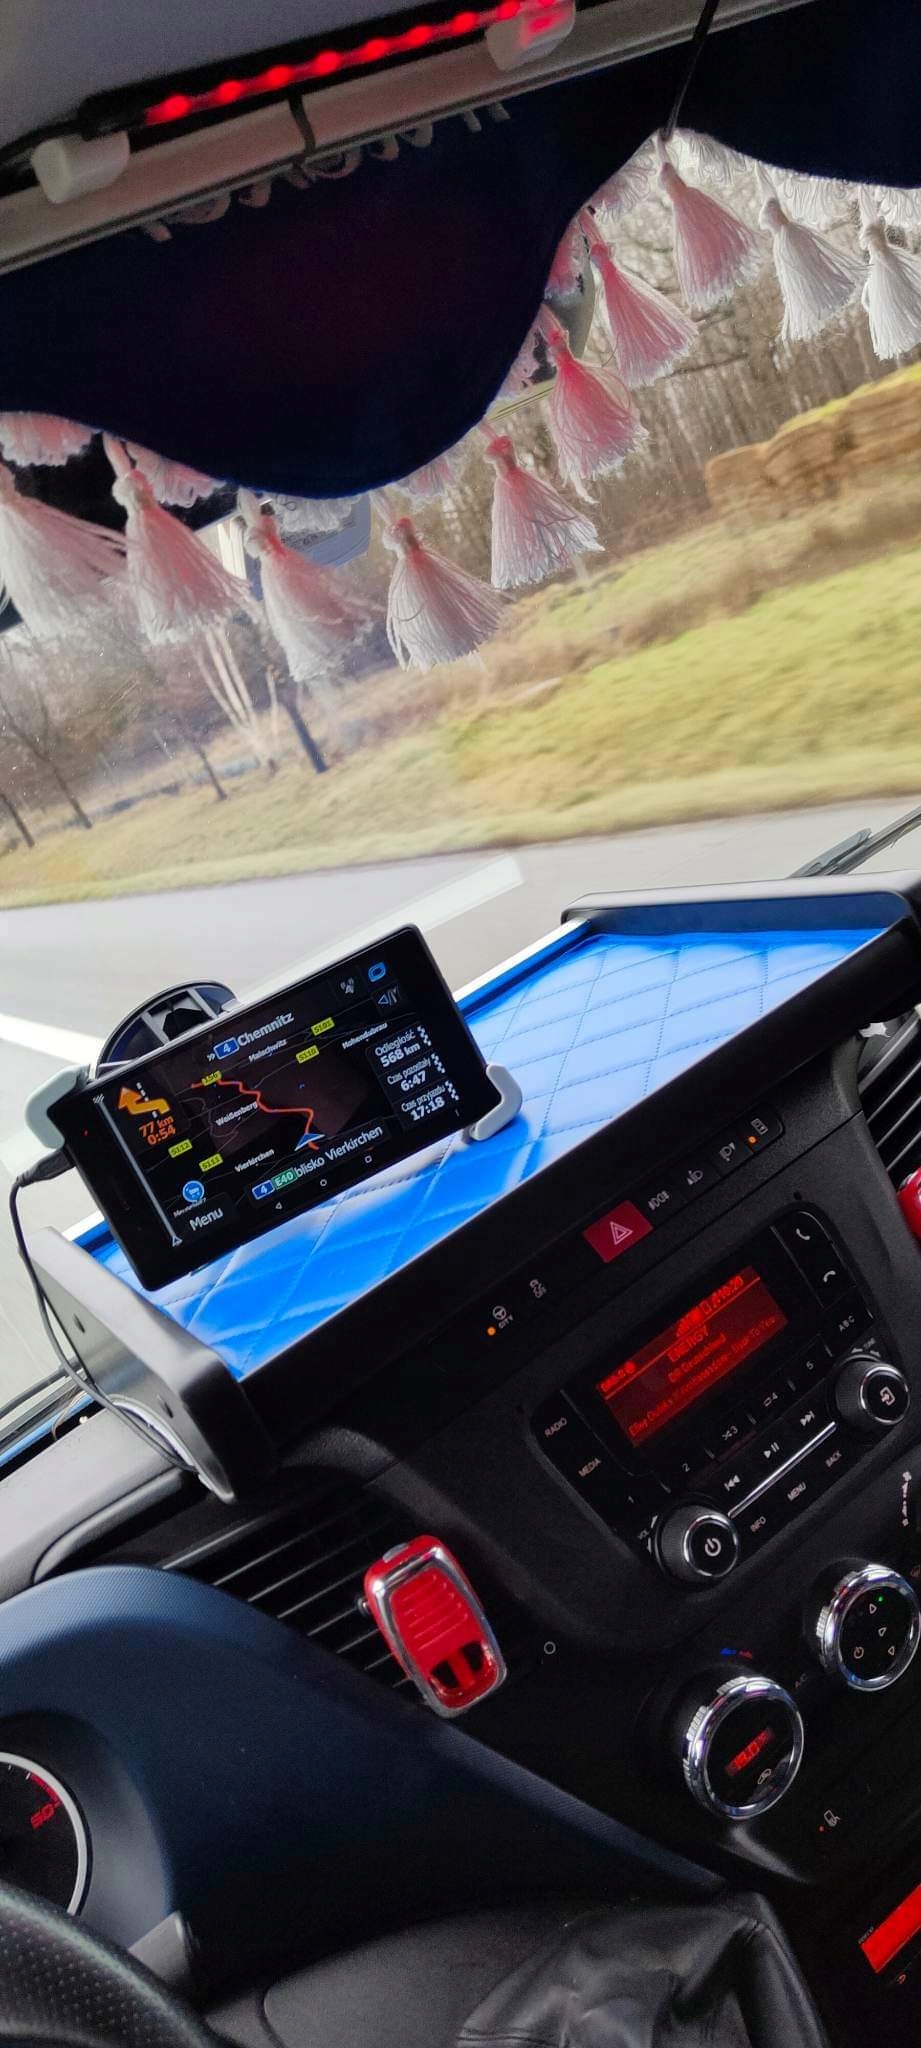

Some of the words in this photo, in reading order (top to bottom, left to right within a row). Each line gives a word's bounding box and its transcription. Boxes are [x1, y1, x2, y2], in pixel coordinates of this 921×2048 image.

[237, 1012, 295, 1046] Chemnitz
[380, 1048, 405, 1067] 568
[404, 1043, 421, 1056] km
[400, 1070, 426, 1091] 6:47
[215, 1101, 258, 1126] Weißenberg
[411, 1096, 445, 1121] 17:18
[139, 1122, 155, 1138] 77
[157, 1116, 175, 1129] km
[147, 1126, 176, 1145] 0:54
[234, 1149, 275, 1173] Vierkirchen
[274, 1171, 295, 1187] E40
[294, 1156, 325, 1177] blisko
[325, 1126, 383, 1161] Vierkirchen
[189, 1207, 224, 1231] Menu
[544, 1417, 568, 1437] RADIO
[578, 1457, 602, 1478] MEDIA
[682, 1462, 691, 1473] 2
[787, 1481, 807, 1501] MENU
[750, 1515, 766, 1533] INFO
